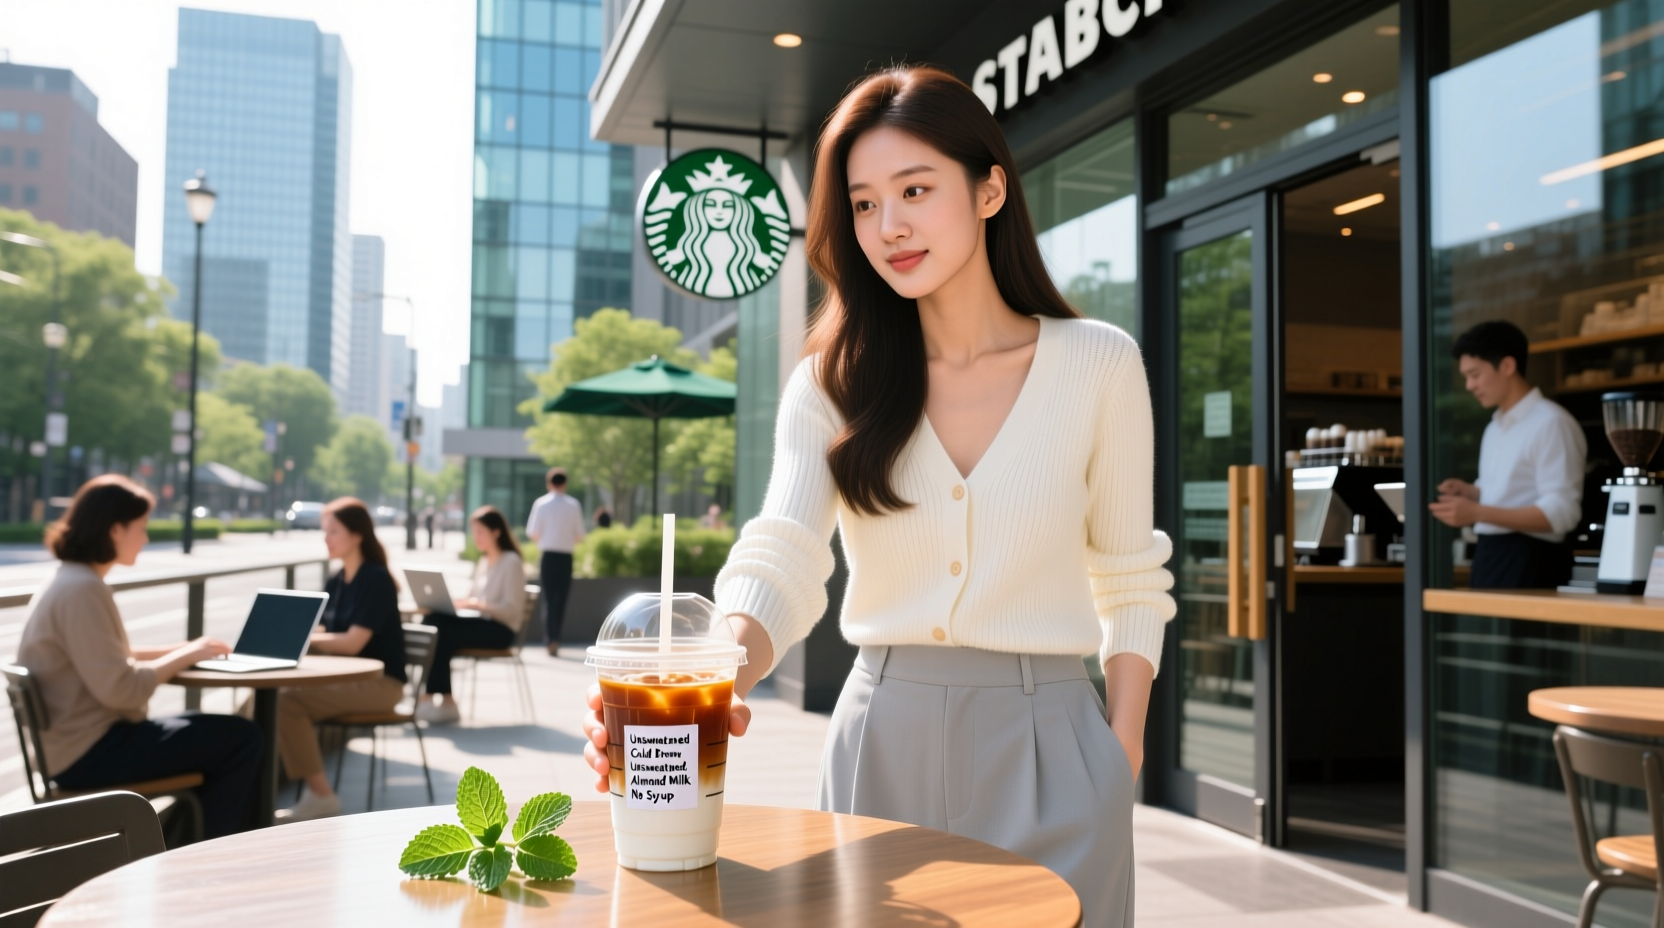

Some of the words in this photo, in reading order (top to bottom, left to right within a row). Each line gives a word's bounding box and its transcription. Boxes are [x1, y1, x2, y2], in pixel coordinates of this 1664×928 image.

[972, 0, 1163, 117] STABC
[630, 774, 667, 787] Almond
[668, 773, 692, 786] Milk
[631, 788, 643, 800] No
